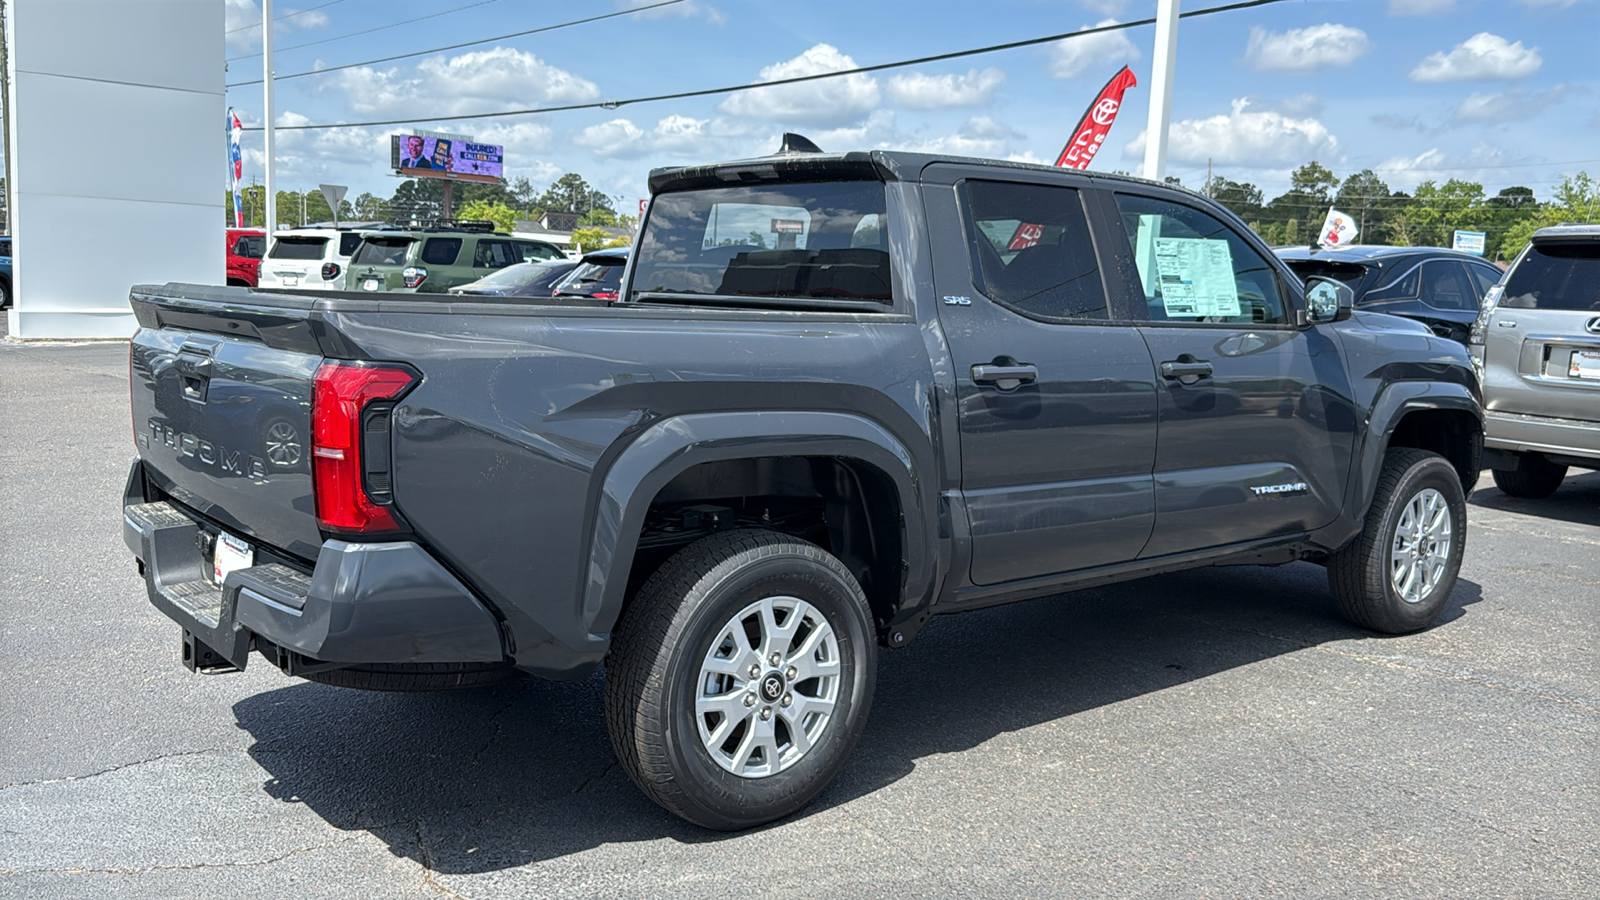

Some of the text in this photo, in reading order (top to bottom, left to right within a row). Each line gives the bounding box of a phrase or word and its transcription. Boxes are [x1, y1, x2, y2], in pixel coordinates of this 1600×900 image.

[943, 295, 972, 305] SR5
[148, 417, 270, 484] TACOMA
[1249, 482, 1307, 495] TACOMA
